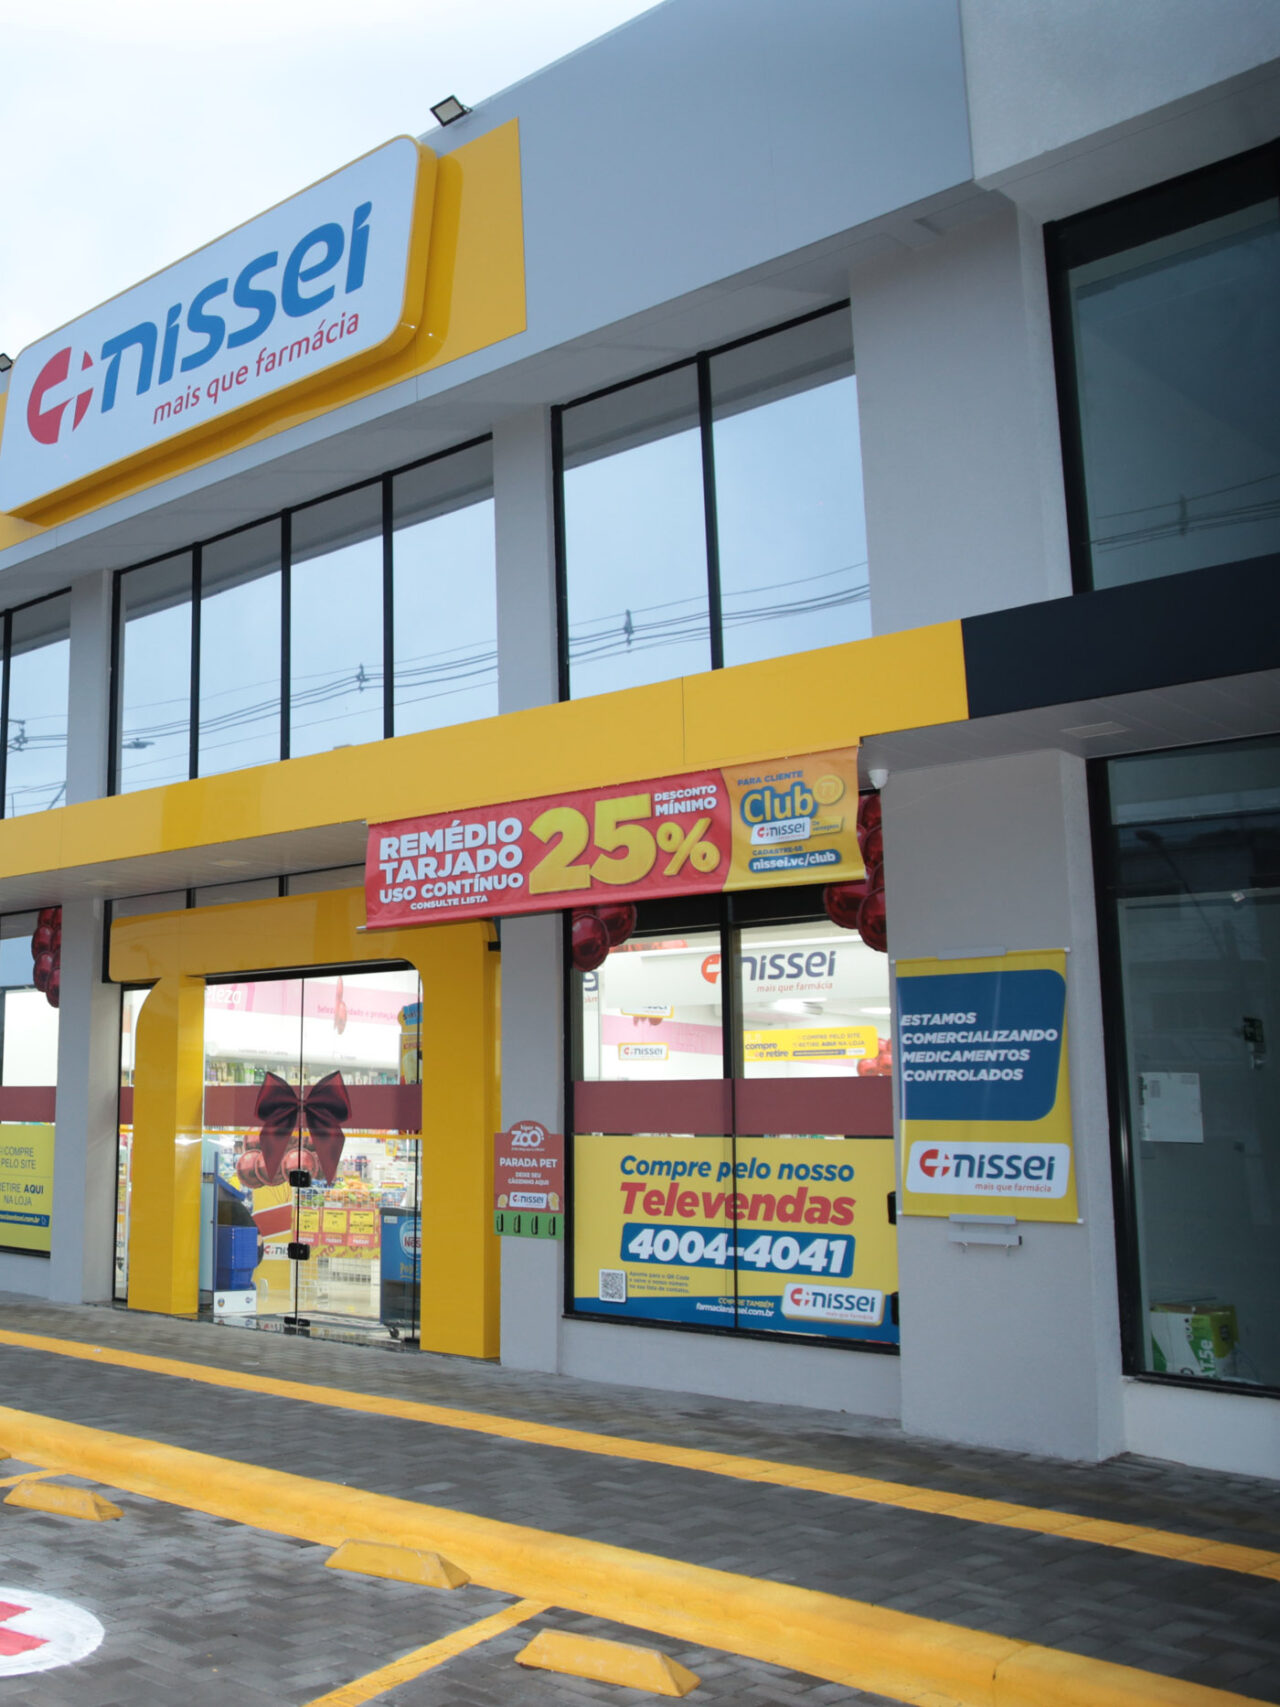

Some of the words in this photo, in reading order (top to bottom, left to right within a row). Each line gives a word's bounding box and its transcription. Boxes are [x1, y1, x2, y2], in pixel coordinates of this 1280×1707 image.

[100, 201, 372, 414] nissei
[153, 384, 201, 425] mais
[206, 368, 248, 405] que
[255, 312, 360, 377] farmácia
[737, 777, 762, 786] PARA
[764, 770, 803, 783] CLIENTE
[654, 785, 717, 802] DESCONTO
[655, 796, 717, 817] MÍNIMO
[744, 785, 814, 823] Club
[770, 822, 805, 837] nissei
[379, 817, 523, 861] REMÉDIO
[528, 793, 720, 895] 25%
[379, 844, 523, 885] TARJADO
[753, 851, 836, 871] nissei.vc/club
[379, 885, 417, 904] USO
[421, 872, 524, 899] CONTÍNUO
[410, 898, 459, 910] CONSULTE
[461, 895, 488, 905] LISTA
[742, 951, 836, 981] nissei
[757, 984, 776, 993] mais
[777, 984, 794, 995] que
[796, 980, 833, 992] farmácia
[900, 1012, 977, 1027] ESTAMOS
[902, 1029, 1058, 1045] COMERCIALIZANDO
[902, 1049, 1030, 1063] MEDICAMENTOS
[903, 1068, 1024, 1082] CONTROLADOS
[4, 1146, 34, 1157] COMPRE
[1, 1158, 19, 1168] PELO
[21, 1159, 36, 1169] SITE
[499, 1157, 538, 1167] PARADA
[539, 1158, 558, 1168] PET
[620, 1155, 712, 1181] Compre
[716, 1157, 771, 1183] pelo
[777, 1162, 855, 1182] nosso
[954, 1154, 1056, 1181] nissei
[23, 1184, 44, 1194] AQUI
[996, 1184, 1011, 1193] que
[1014, 1182, 1052, 1193] farmácia
[4, 1195, 14, 1204] NA
[14, 1196, 32, 1206] LOJA
[620, 1182, 856, 1226] Televendas
[627, 1228, 847, 1274] 4004-4041
[811, 1291, 876, 1313] nissei
